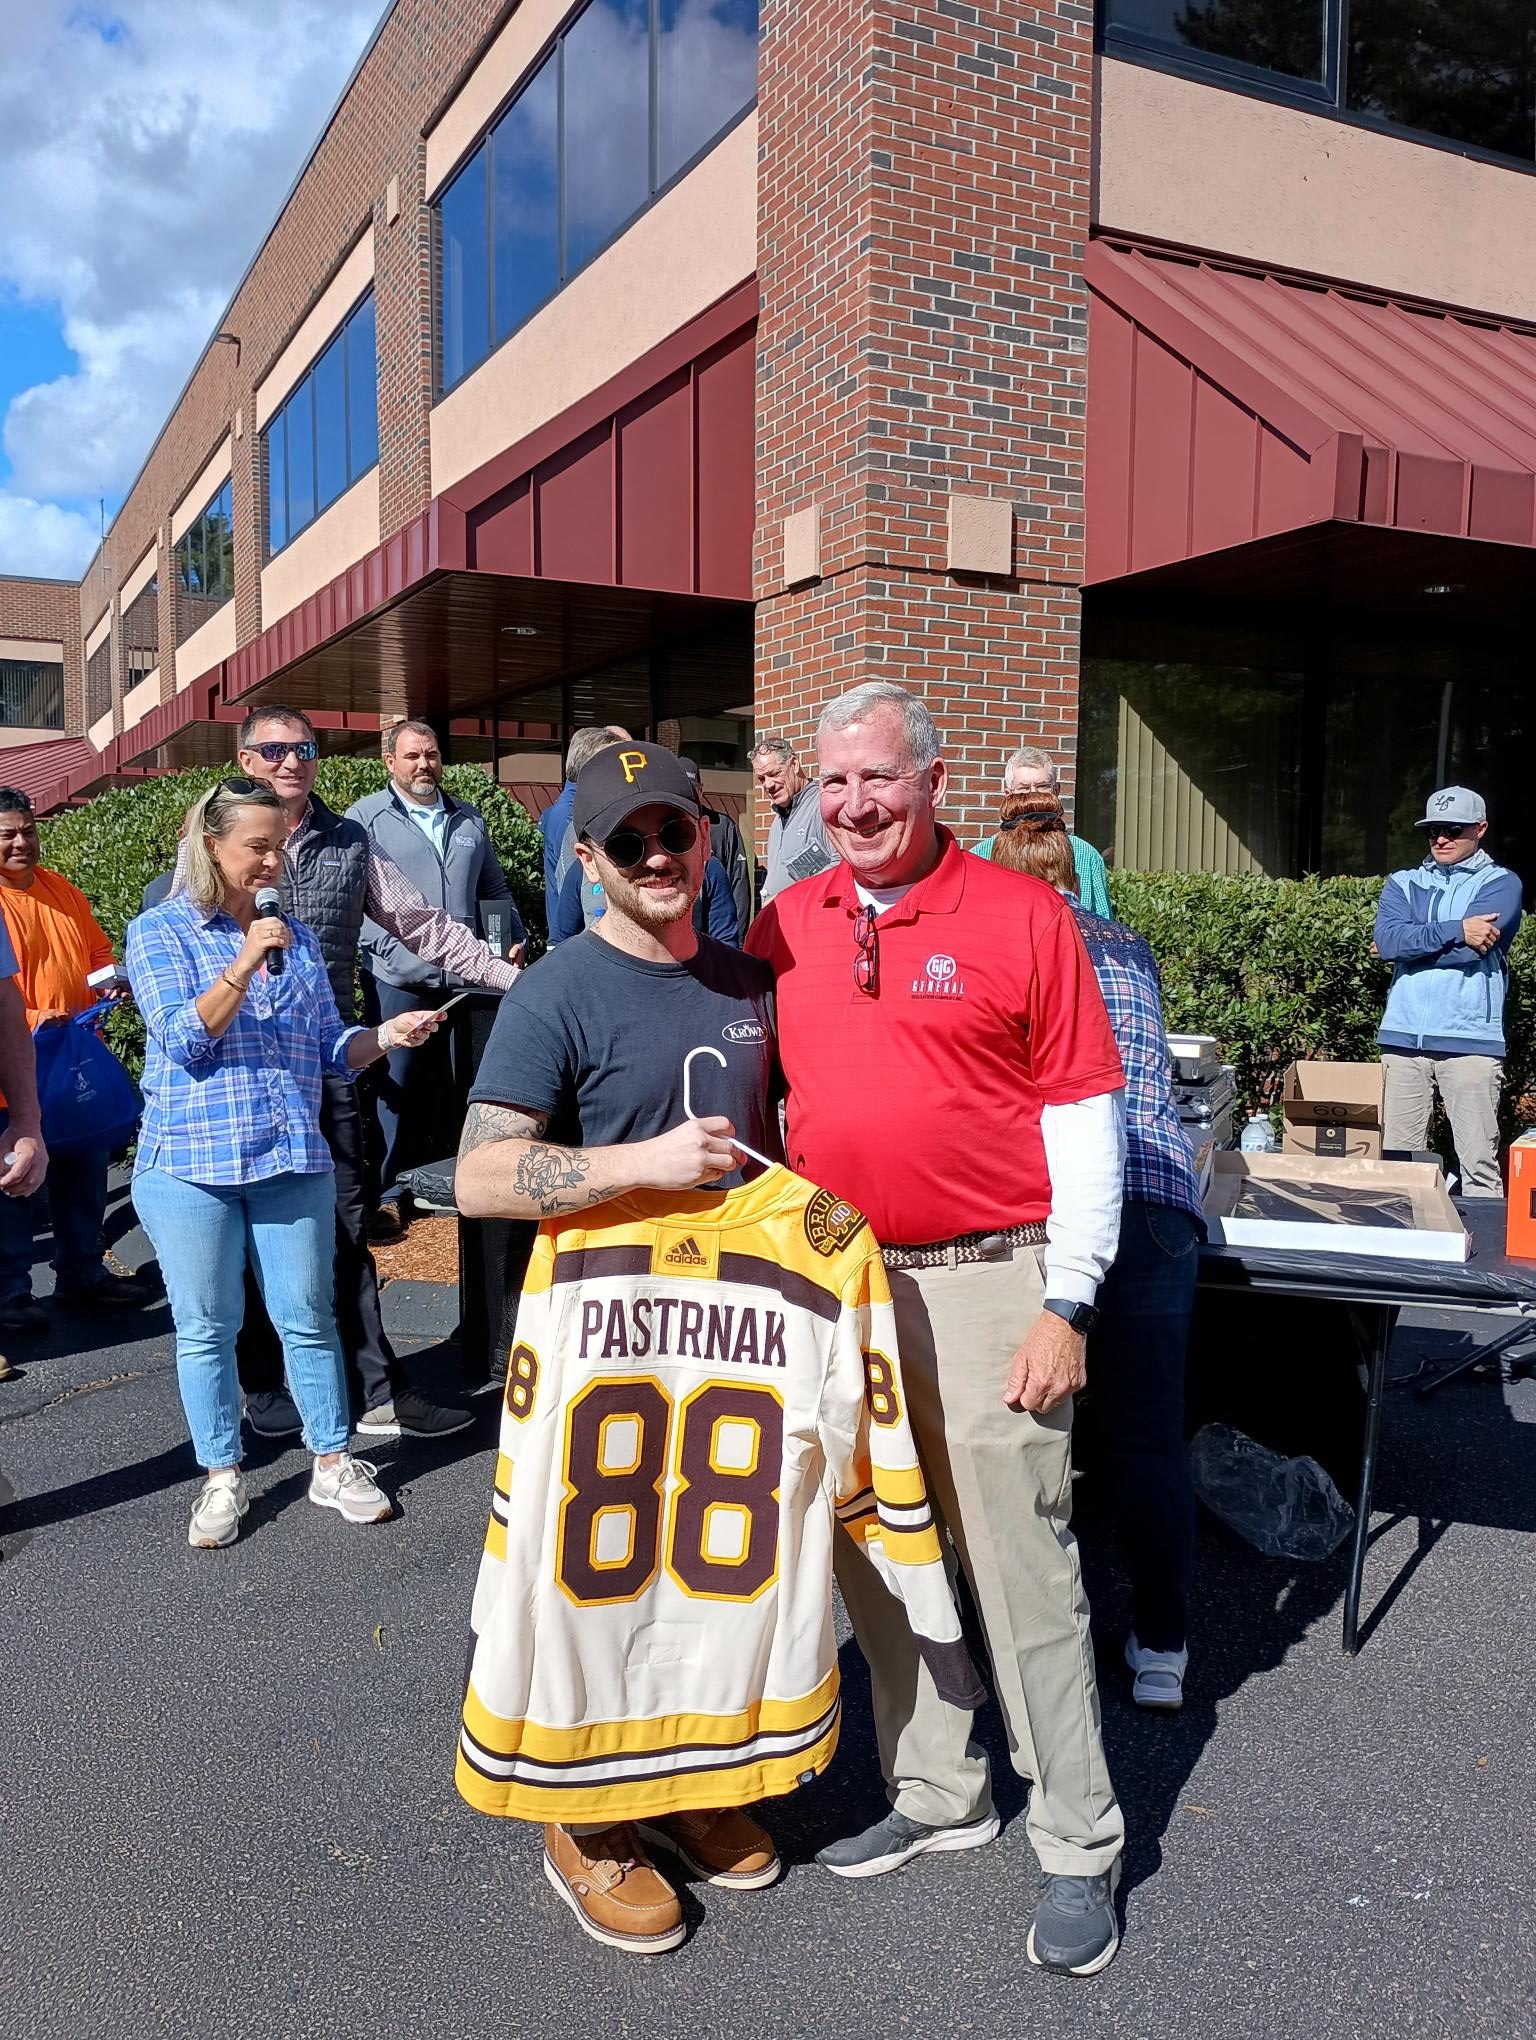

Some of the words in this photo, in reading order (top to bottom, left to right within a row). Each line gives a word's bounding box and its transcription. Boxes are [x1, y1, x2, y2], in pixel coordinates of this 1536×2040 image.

[619, 751, 648, 783] P
[911, 980, 965, 994] GENERAL
[811, 1192, 839, 1239] BRUI
[830, 1205, 851, 1226] 100
[665, 1253, 708, 1266] adidas
[579, 1298, 787, 1367] PASTRNAK
[505, 1340, 541, 1424] 8
[555, 1374, 785, 1608] 88
